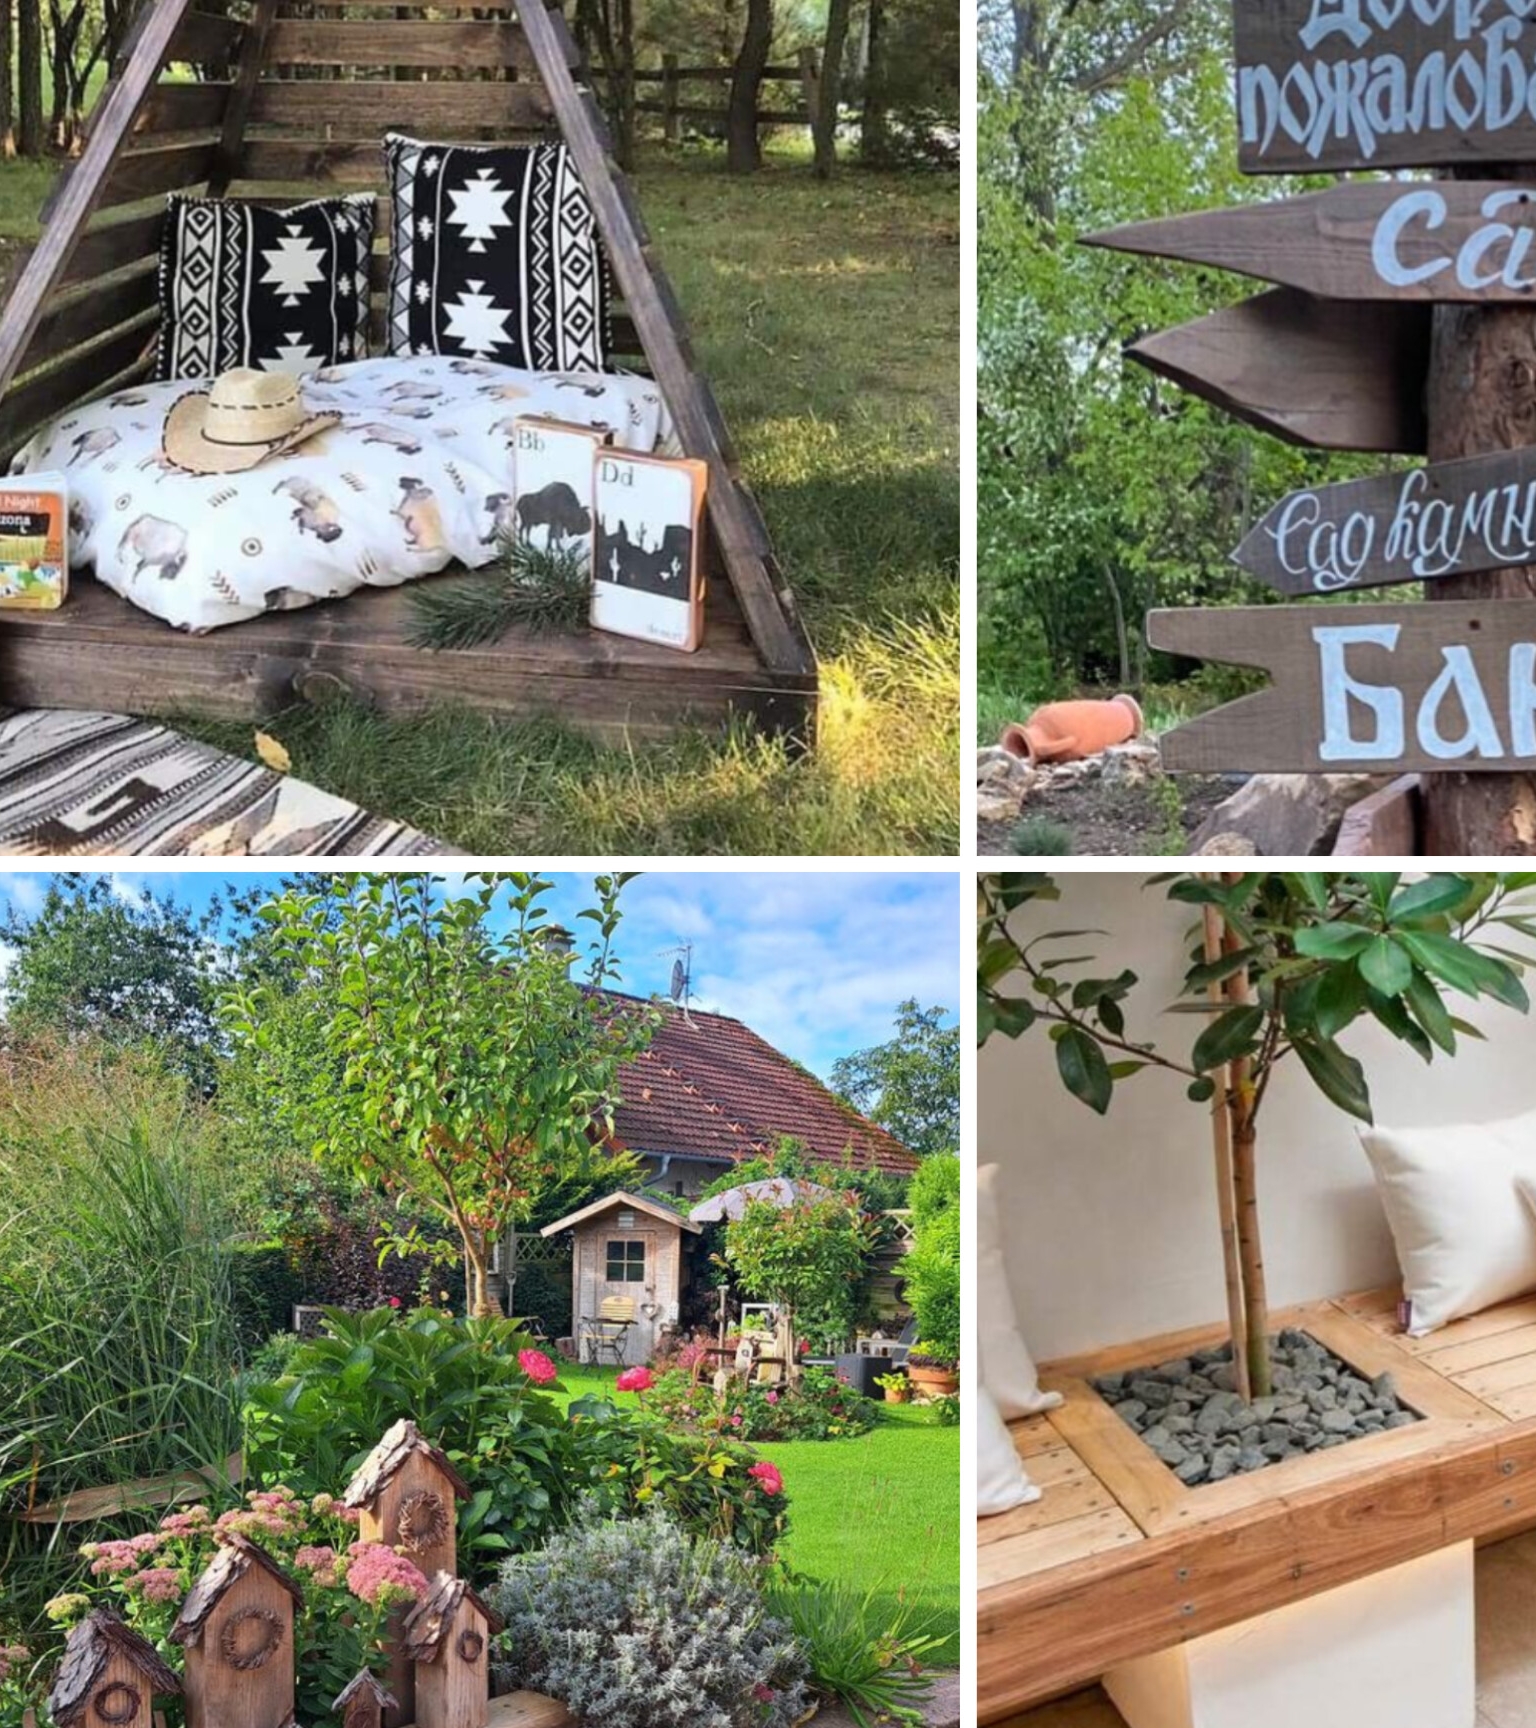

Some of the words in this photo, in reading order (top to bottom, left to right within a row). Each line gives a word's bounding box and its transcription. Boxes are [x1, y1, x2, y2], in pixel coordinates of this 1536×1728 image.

[518, 429, 545, 452] Bb
[601, 460, 635, 487] Dd
[1264, 493, 1376, 592] Сад
